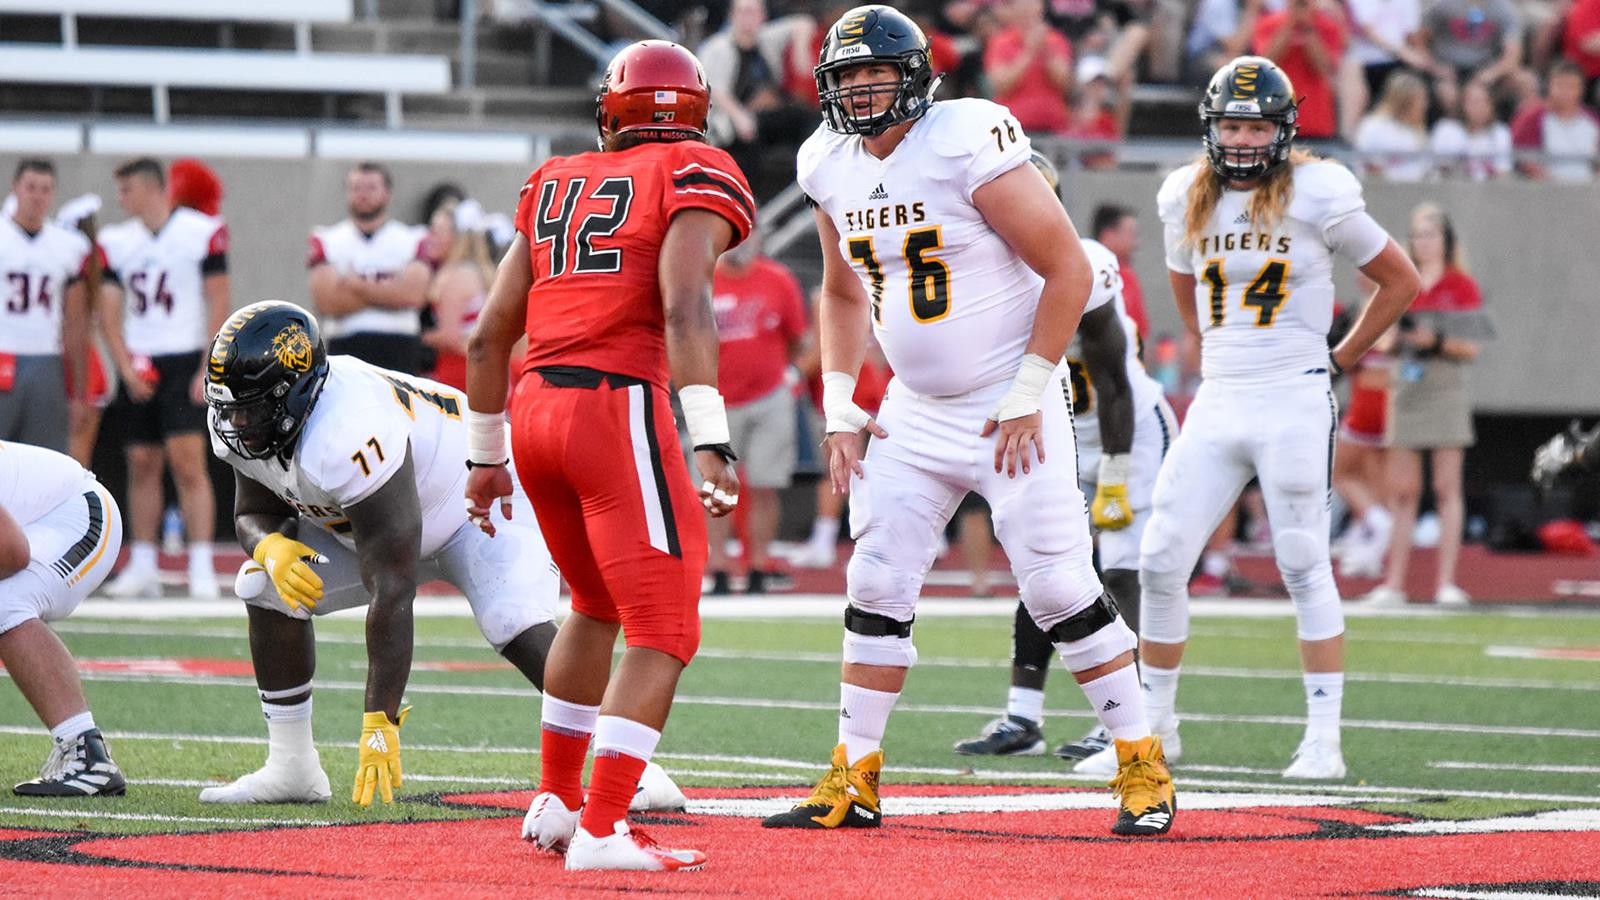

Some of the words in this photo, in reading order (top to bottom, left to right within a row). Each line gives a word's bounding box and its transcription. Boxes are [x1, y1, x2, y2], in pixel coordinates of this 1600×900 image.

[990, 119, 1017, 152] 76
[534, 176, 634, 278] 42
[846, 202, 925, 231] TIGERS
[1199, 233, 1292, 256] TIGERS
[7, 272, 52, 314] 34
[129, 271, 174, 317] 54
[847, 225, 951, 325] 76
[1200, 257, 1294, 328] 14
[351, 436, 385, 478] 77
